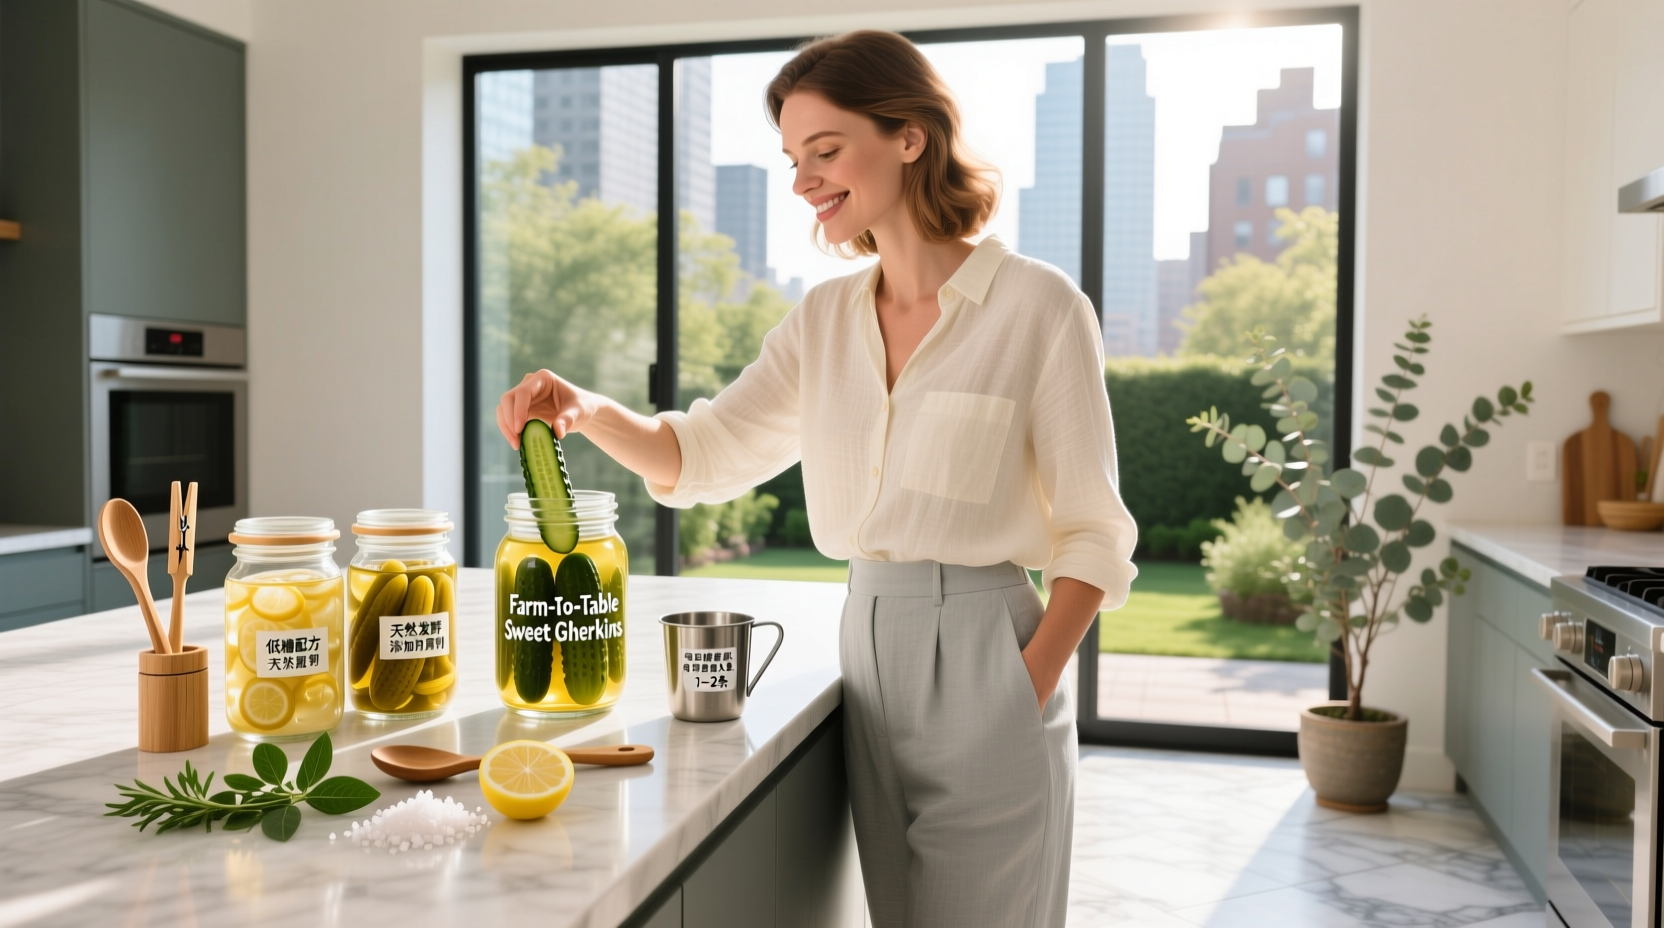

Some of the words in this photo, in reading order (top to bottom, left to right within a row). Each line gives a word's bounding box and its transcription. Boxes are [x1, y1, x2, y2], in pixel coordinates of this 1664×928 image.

[509, 592, 619, 617] Farm-To-Table
[504, 618, 552, 642] Sweet
[554, 618, 623, 642] Gherkins
